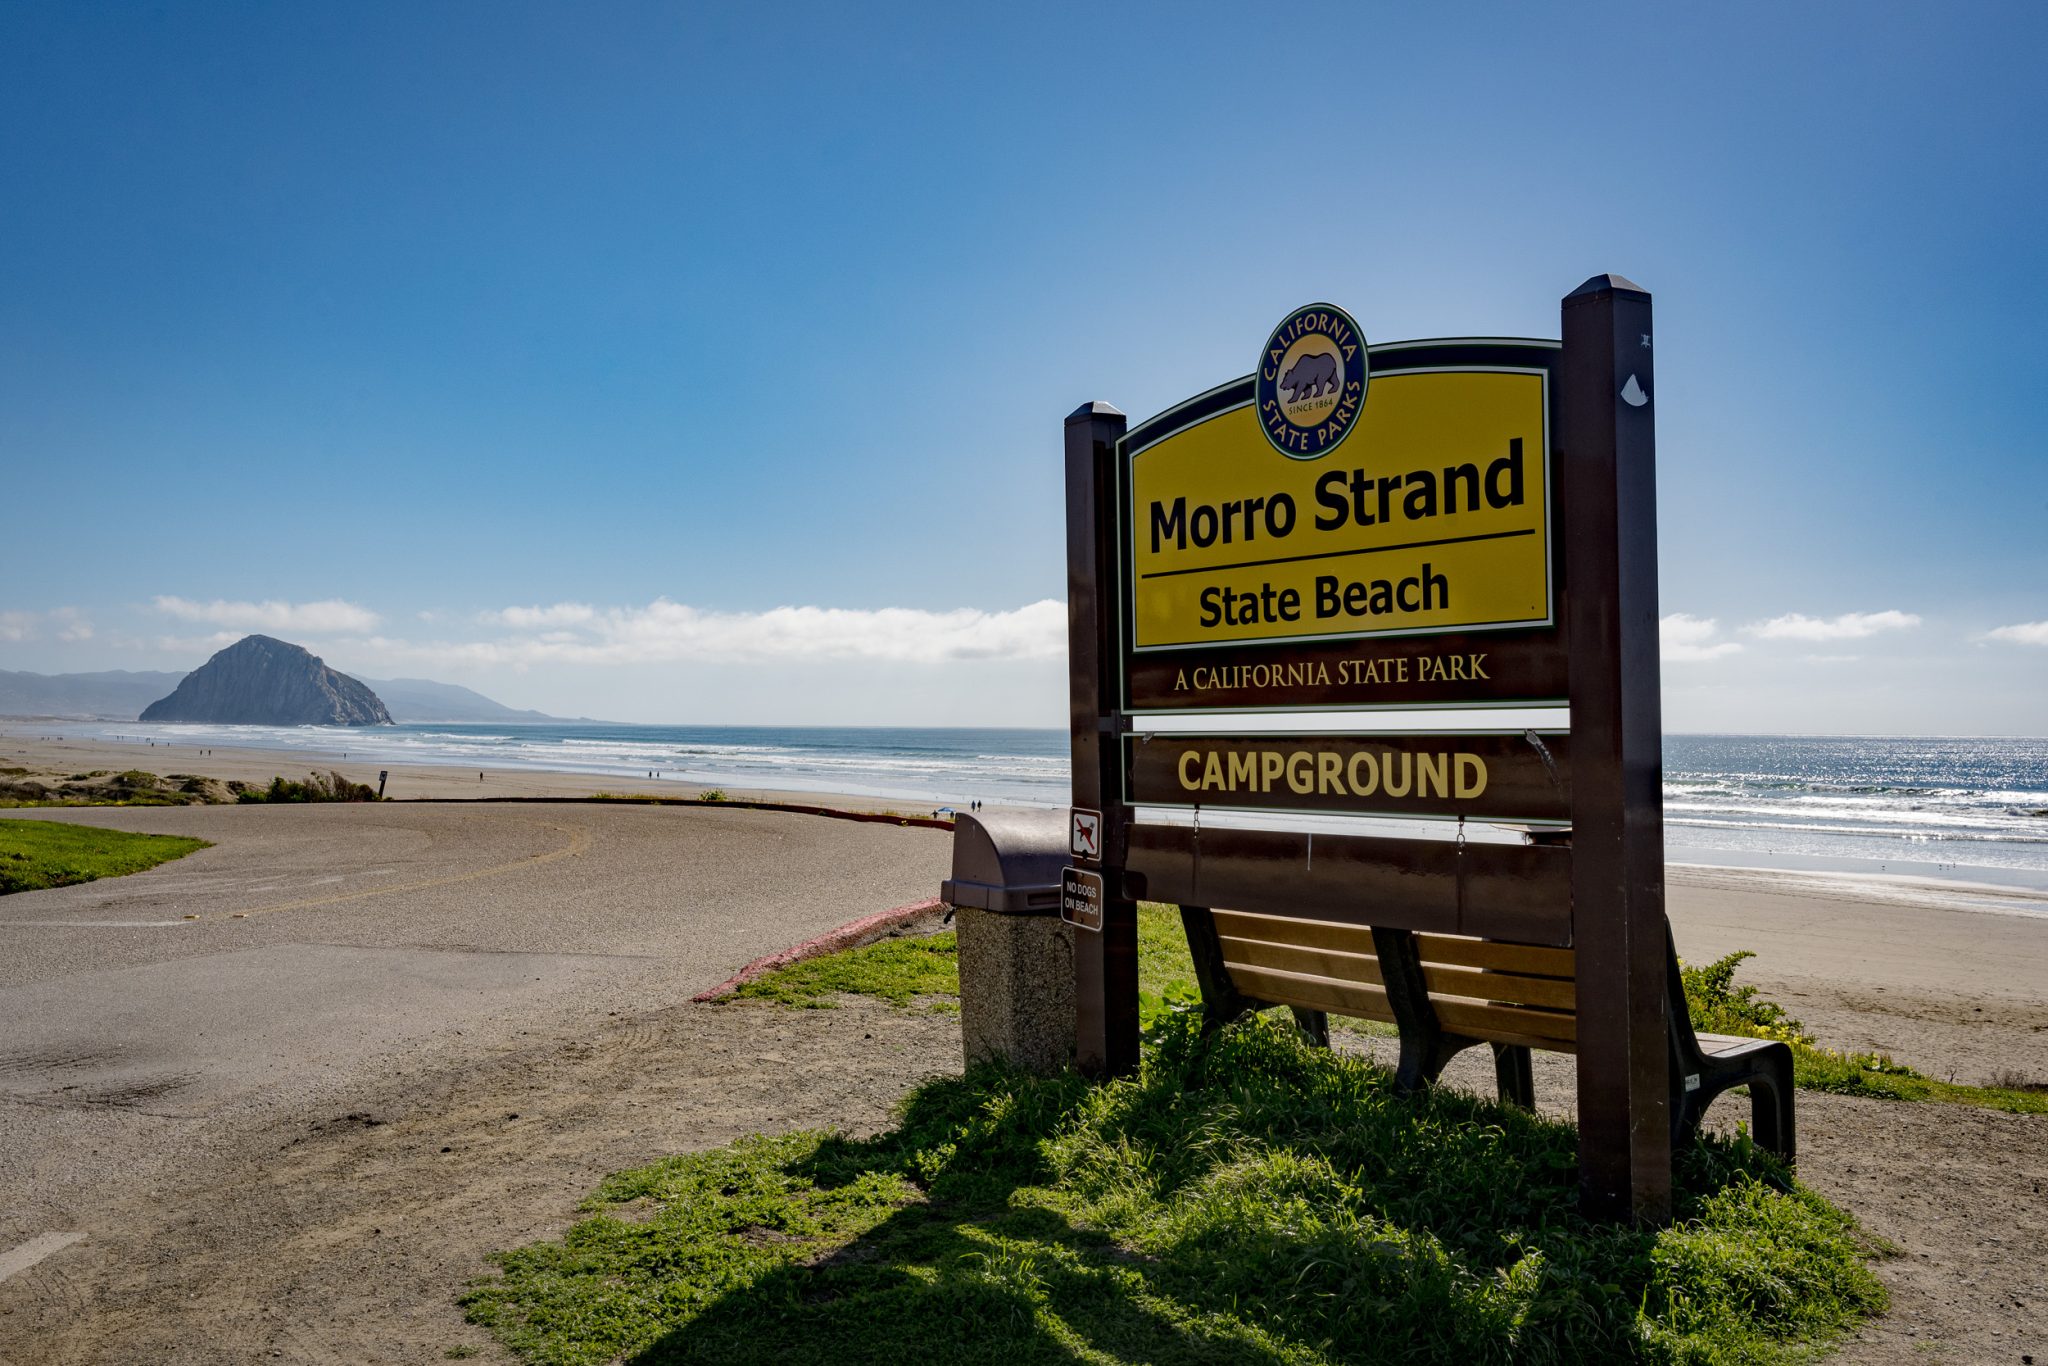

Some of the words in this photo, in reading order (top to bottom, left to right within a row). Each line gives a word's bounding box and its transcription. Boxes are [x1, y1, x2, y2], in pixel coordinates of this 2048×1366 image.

[1264, 313, 1357, 381] CALIFORNIA
[1263, 400, 1308, 450] STATE
[1318, 381, 1360, 446] PARKS
[1288, 402, 1312, 415] SINCE
[1315, 398, 1334, 409] 1864
[1150, 492, 1296, 553] Morro
[1315, 437, 1525, 532] Strand
[1200, 582, 1301, 628] State
[1315, 563, 1449, 619] Beach
[1174, 669, 1189, 691] A
[1193, 662, 1332, 690] CALIFORNIA
[1338, 658, 1409, 685] STATE
[1417, 653, 1491, 682] PARK
[1178, 750, 1488, 799] CAMPGROUND
[1064, 897, 1075, 909] ON
[1075, 899, 1099, 916] BEACH
[1066, 881, 1077, 893] NO
[1077, 883, 1097, 898] DOGS
